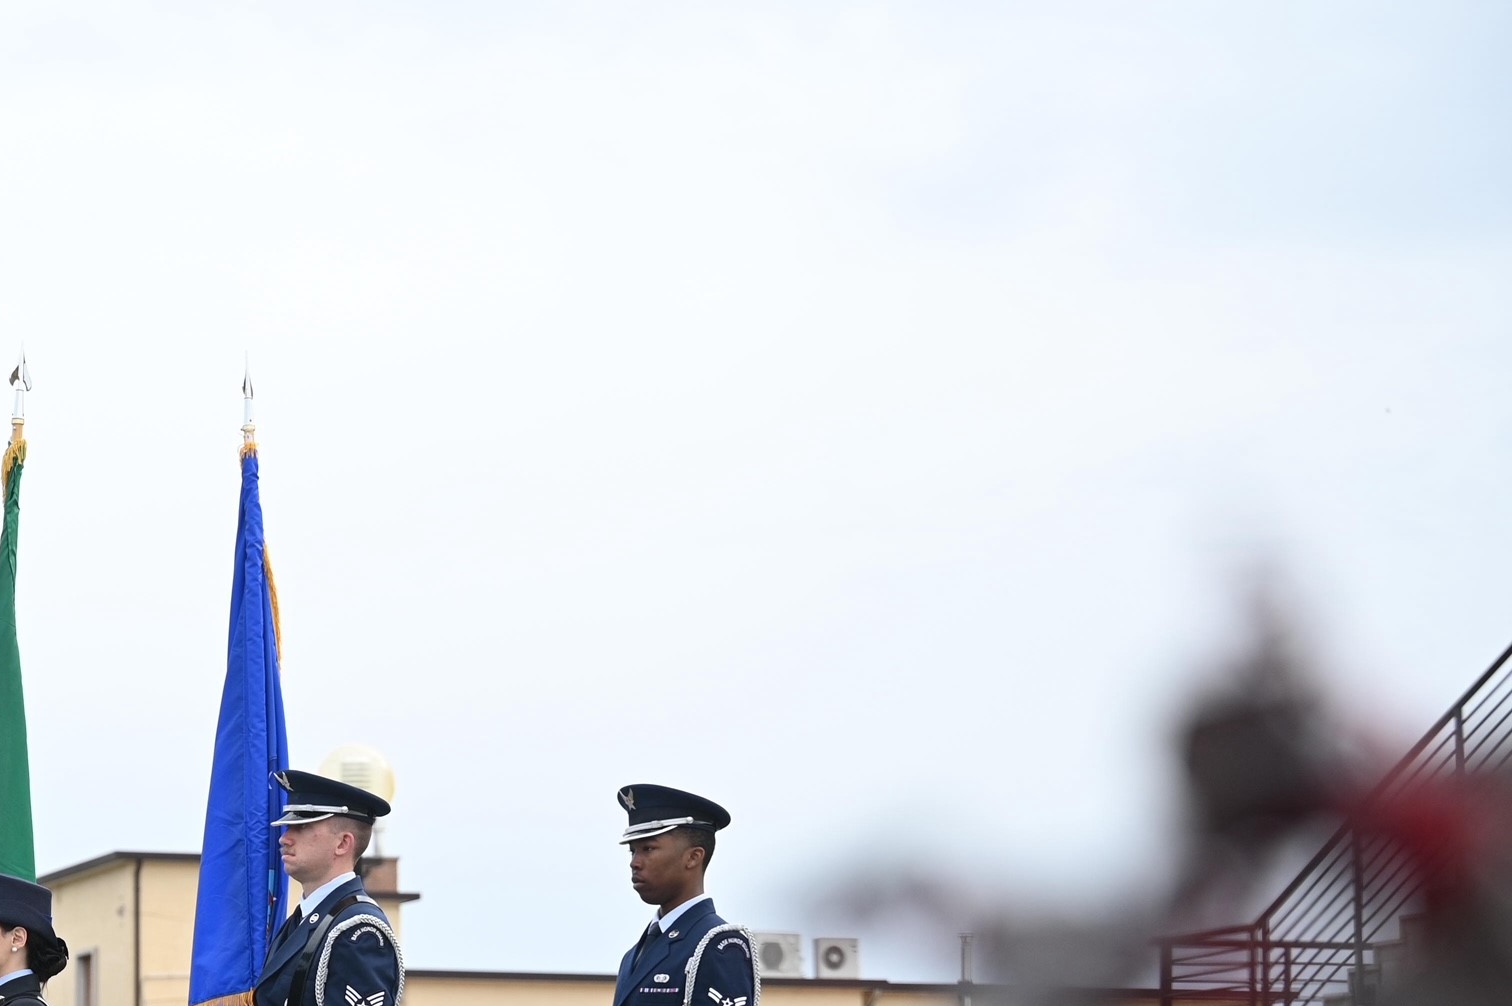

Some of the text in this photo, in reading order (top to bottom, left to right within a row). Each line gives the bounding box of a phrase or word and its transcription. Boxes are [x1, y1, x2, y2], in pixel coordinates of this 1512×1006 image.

[351, 929, 361, 941] BASE
[717, 939, 728, 950] BASE
[728, 937, 743, 945] HONOR
